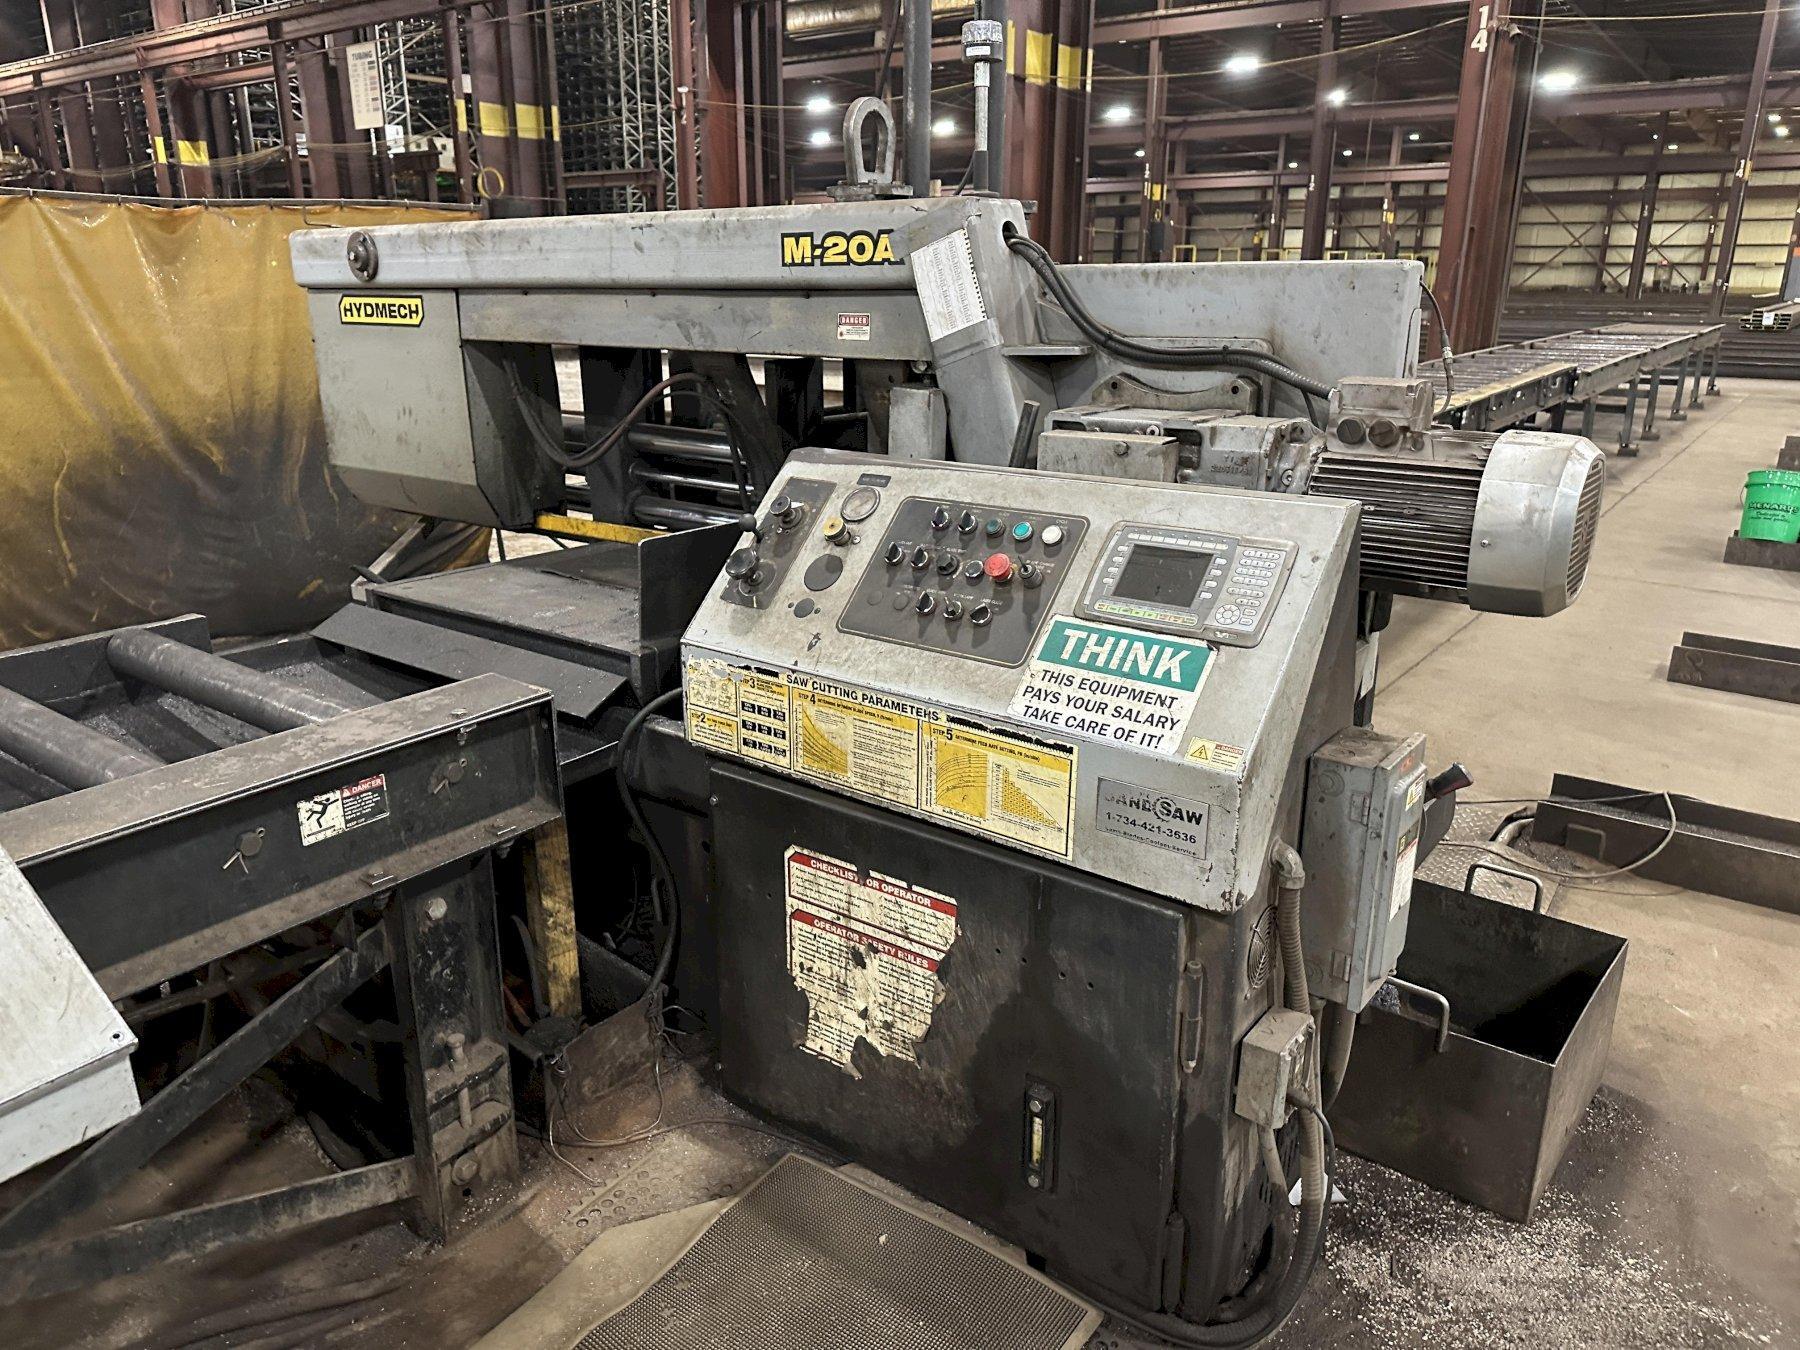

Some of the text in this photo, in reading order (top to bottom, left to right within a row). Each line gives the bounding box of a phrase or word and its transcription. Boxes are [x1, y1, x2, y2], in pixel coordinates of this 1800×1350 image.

[1471, 5, 1489, 52] 14
[782, 230, 897, 265] M-20A
[343, 302, 420, 319] HYDMECH
[841, 316, 867, 324] DANGER
[1060, 628, 1192, 683] THINK
[786, 675, 809, 688] SAW
[812, 681, 858, 701] CUTTING
[809, 694, 816, 704] 4
[1041, 669, 1178, 709] THIS EQUIPMENT
[1022, 686, 1181, 732] PAYS YOUR SALARY
[933, 728, 945, 736] STEP
[946, 729, 953, 740] 5
[1022, 705, 1164, 749] TAKE CARE OF IT!
[352, 779, 382, 792] DANGER
[881, 884, 932, 907] OPERATOR
[813, 918, 859, 942] OPERATOR
[898, 952, 929, 968] RULES
